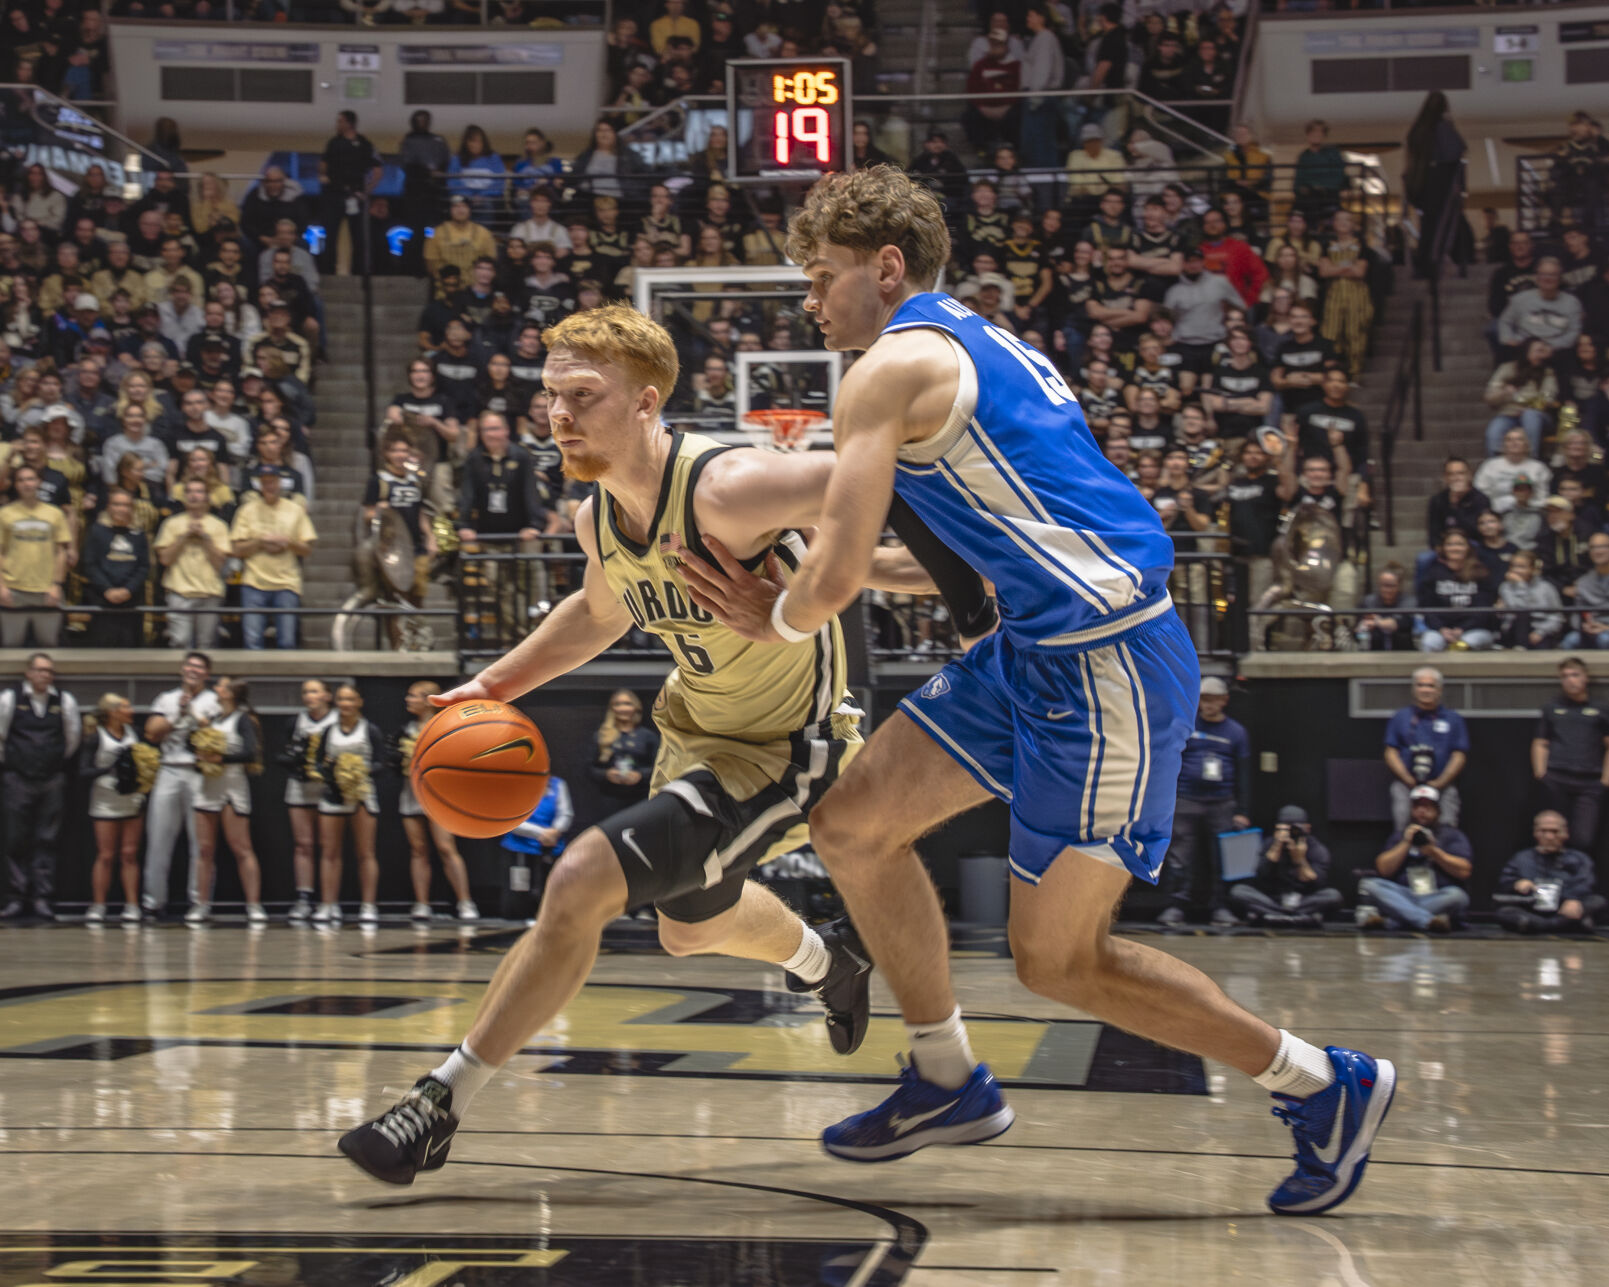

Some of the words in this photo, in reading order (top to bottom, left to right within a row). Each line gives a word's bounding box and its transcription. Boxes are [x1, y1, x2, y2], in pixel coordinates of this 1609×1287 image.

[773, 71, 838, 104] 1:05
[775, 107, 830, 164] 19
[936, 297, 978, 321] AU
[982, 325, 1078, 406] 15
[622, 579, 724, 632] URDU
[673, 632, 715, 675] 6
